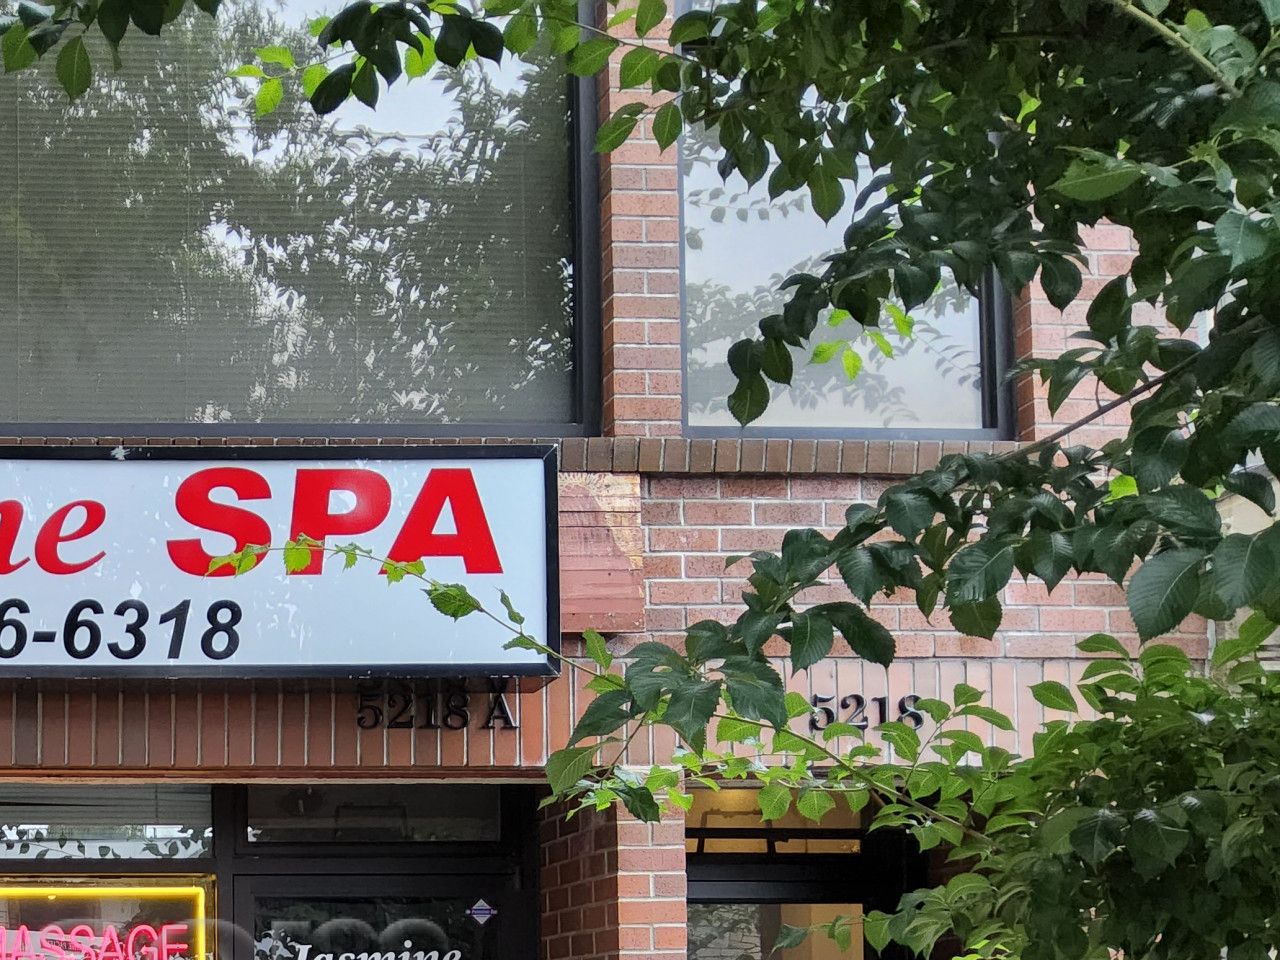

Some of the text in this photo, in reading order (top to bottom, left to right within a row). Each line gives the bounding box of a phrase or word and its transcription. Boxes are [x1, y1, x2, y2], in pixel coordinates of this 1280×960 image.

[166, 466, 504, 577] SPA
[357, 690, 519, 730] 5218 A
[809, 694, 925, 731] 5218
